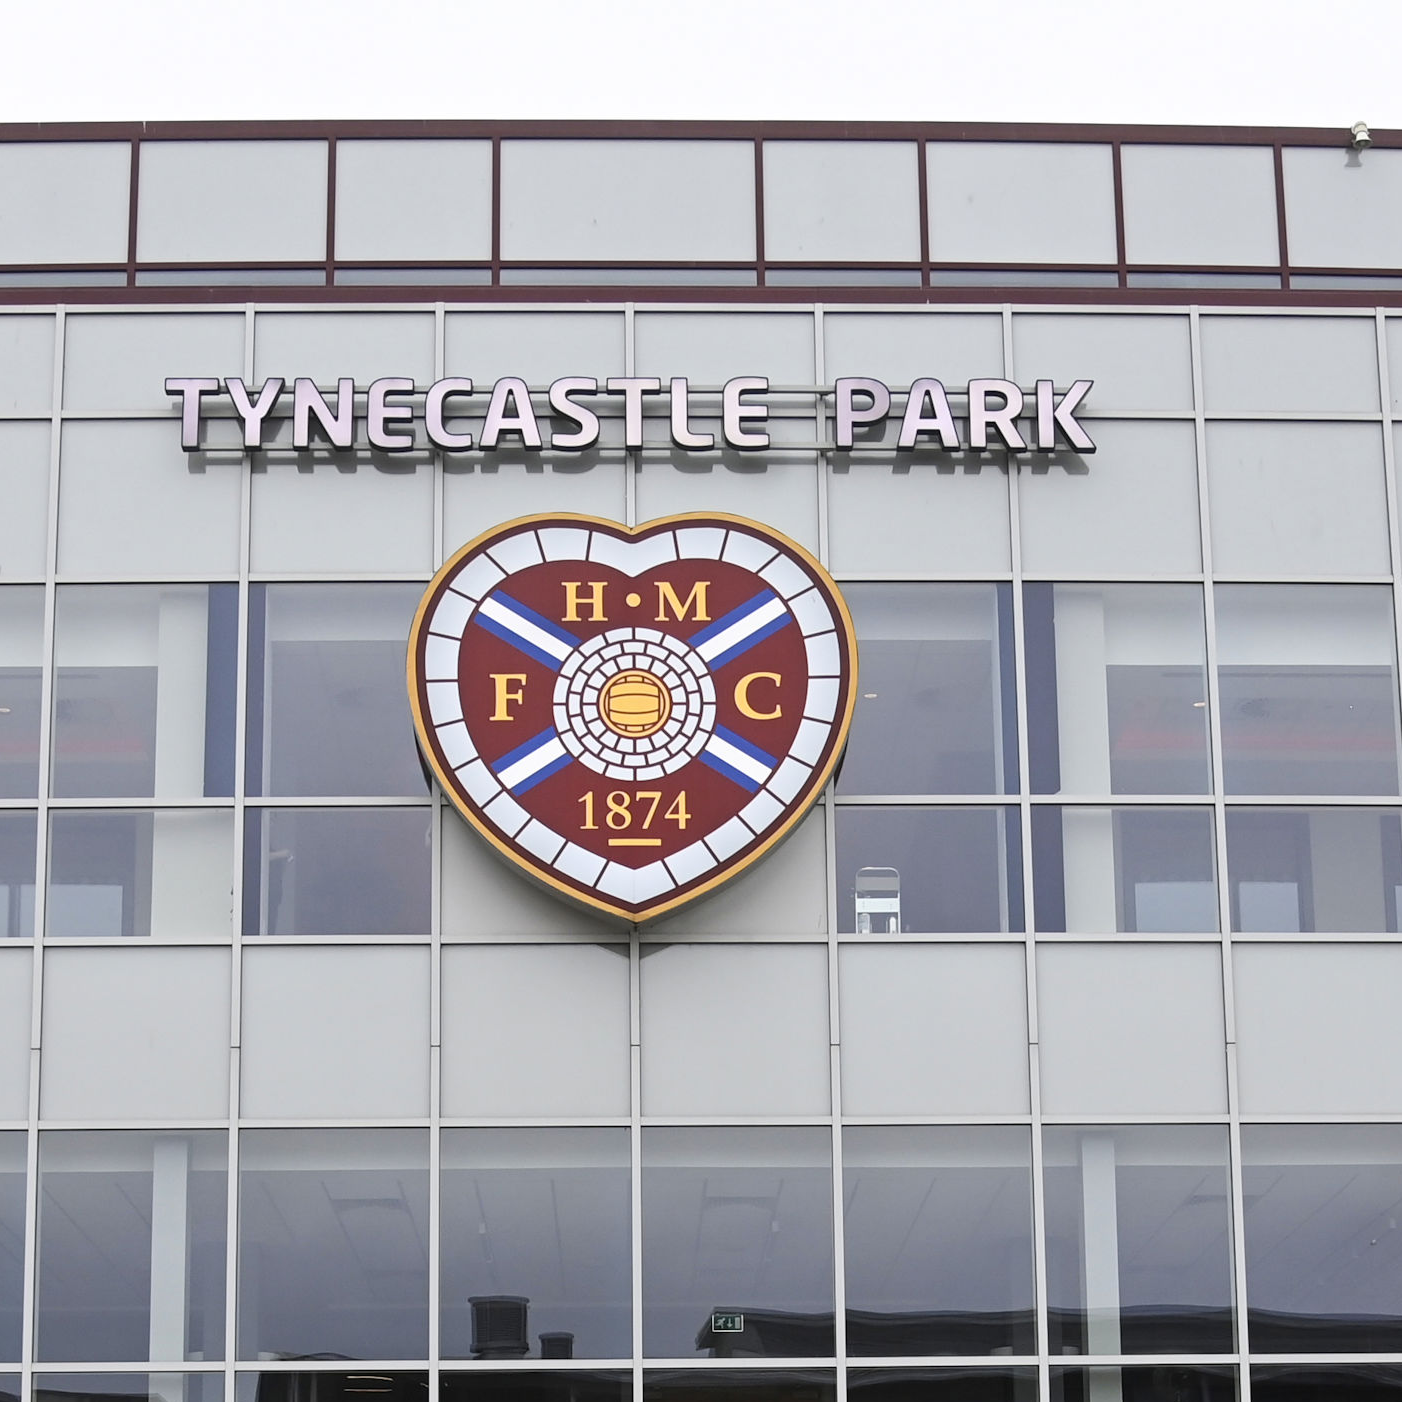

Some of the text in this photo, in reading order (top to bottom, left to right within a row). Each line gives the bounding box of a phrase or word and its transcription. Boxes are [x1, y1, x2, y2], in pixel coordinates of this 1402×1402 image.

[165, 376, 1097, 453] TYNECASTLE PARK
[561, 581, 711, 622] H M
[489, 673, 527, 721] F
[733, 671, 783, 720] C
[577, 789, 691, 830] 1874
